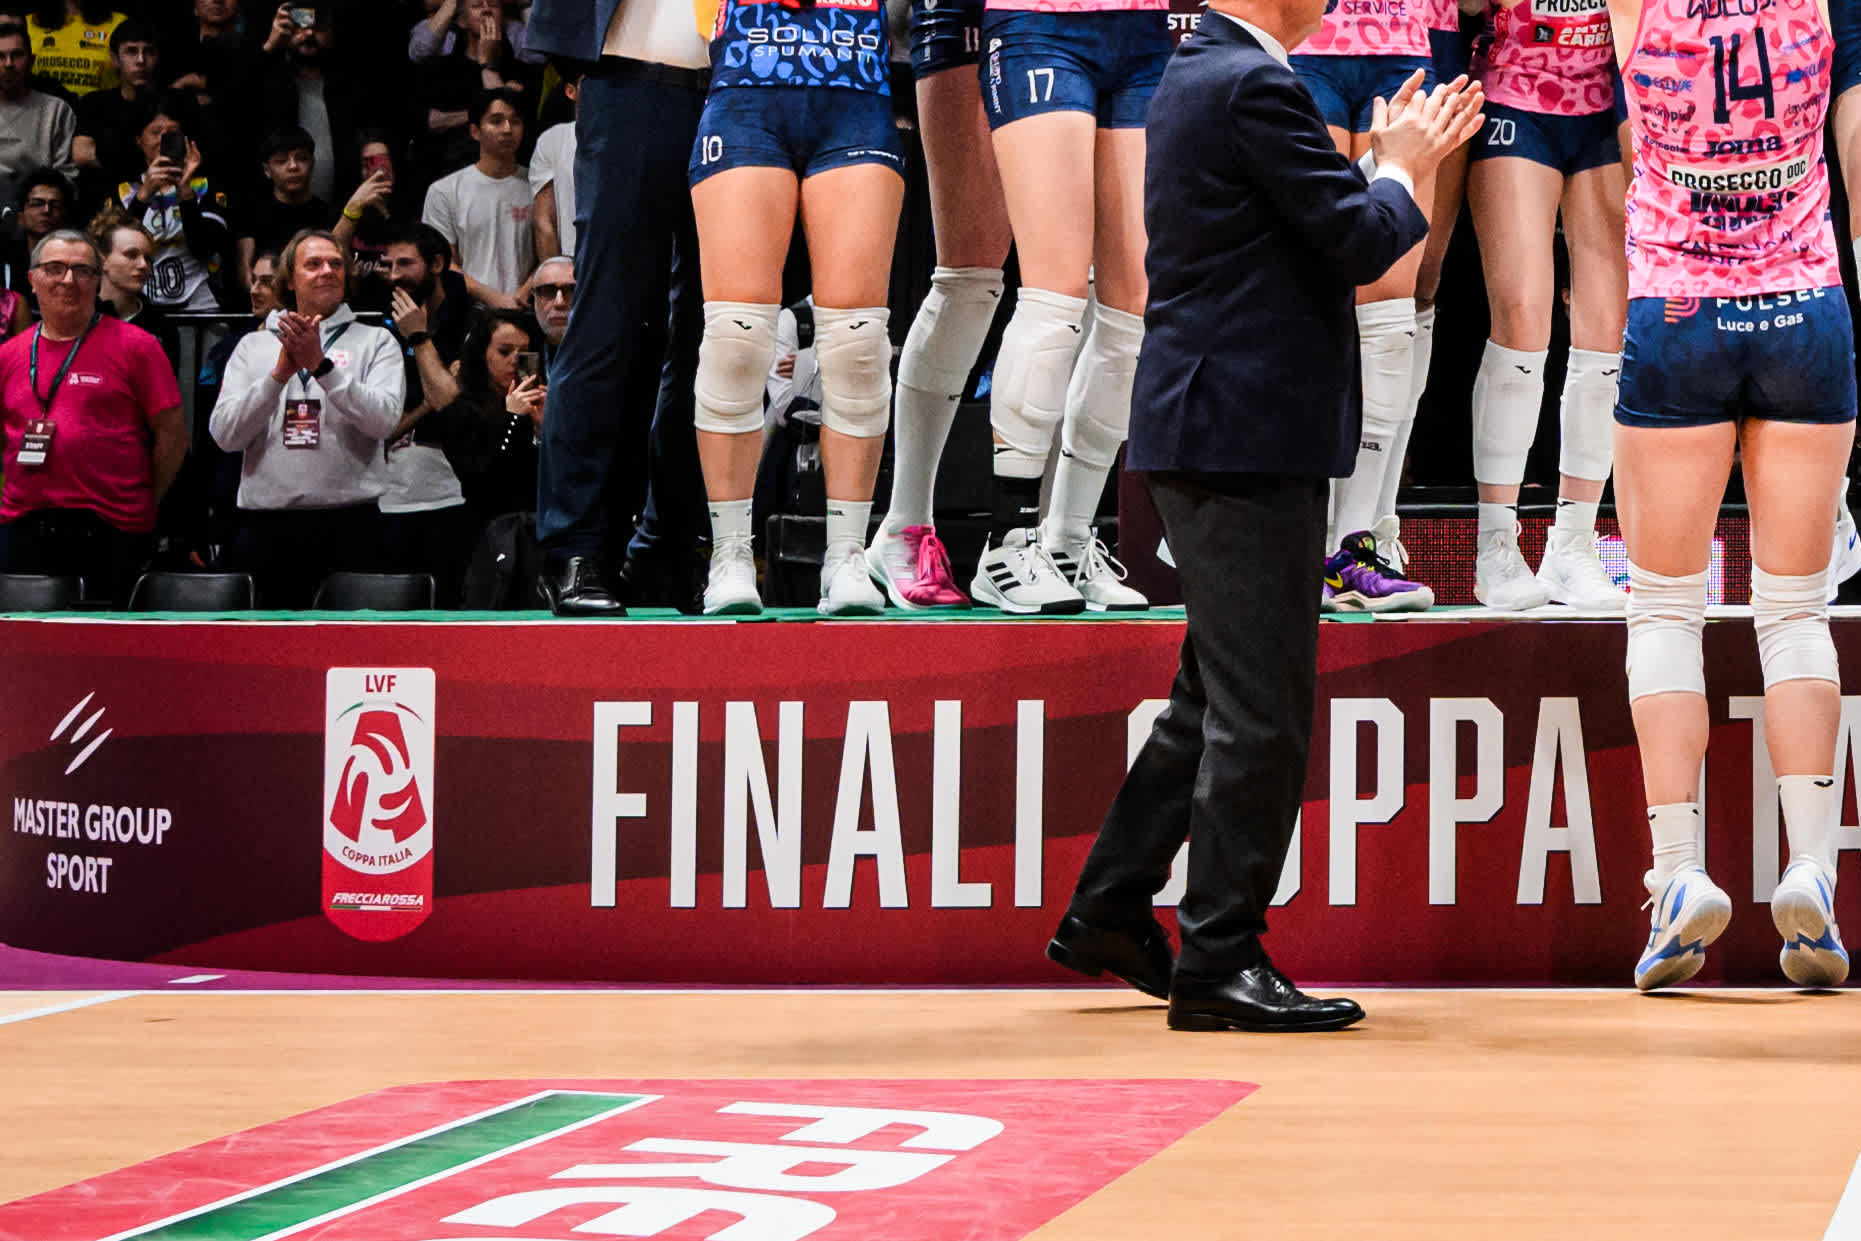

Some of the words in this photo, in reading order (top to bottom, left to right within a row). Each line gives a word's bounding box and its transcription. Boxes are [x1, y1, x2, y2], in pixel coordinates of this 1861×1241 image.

[1343, 0, 1406, 17] SERVICE
[1167, 13, 1202, 30] STE
[1561, 23, 1609, 34] ANTO
[747, 26, 879, 50] SOLIGO
[963, 26, 979, 53] 11
[753, 44, 873, 64] SPUMANTI
[1027, 67, 1055, 103] 17
[1709, 26, 1774, 124] 14
[1487, 118, 1516, 146] 20
[701, 135, 723, 165] 10
[1671, 168, 1782, 192] PROSECCO
[1787, 160, 1806, 179] DOC
[1717, 316, 1755, 332] Luce
[1759, 320, 1769, 331] e
[1774, 313, 1804, 329] Gas
[364, 673, 398, 694] LVF
[592, 700, 1045, 908] FINALI
[1126, 698, 1602, 907] PPA
[13, 796, 81, 840] MASTER
[84, 803, 172, 845] GROUP
[341, 844, 376, 867] COPPA
[377, 846, 413, 867] ITALIA
[46, 851, 113, 894] SPORT
[331, 891, 424, 907] FRECCIAROSSA
